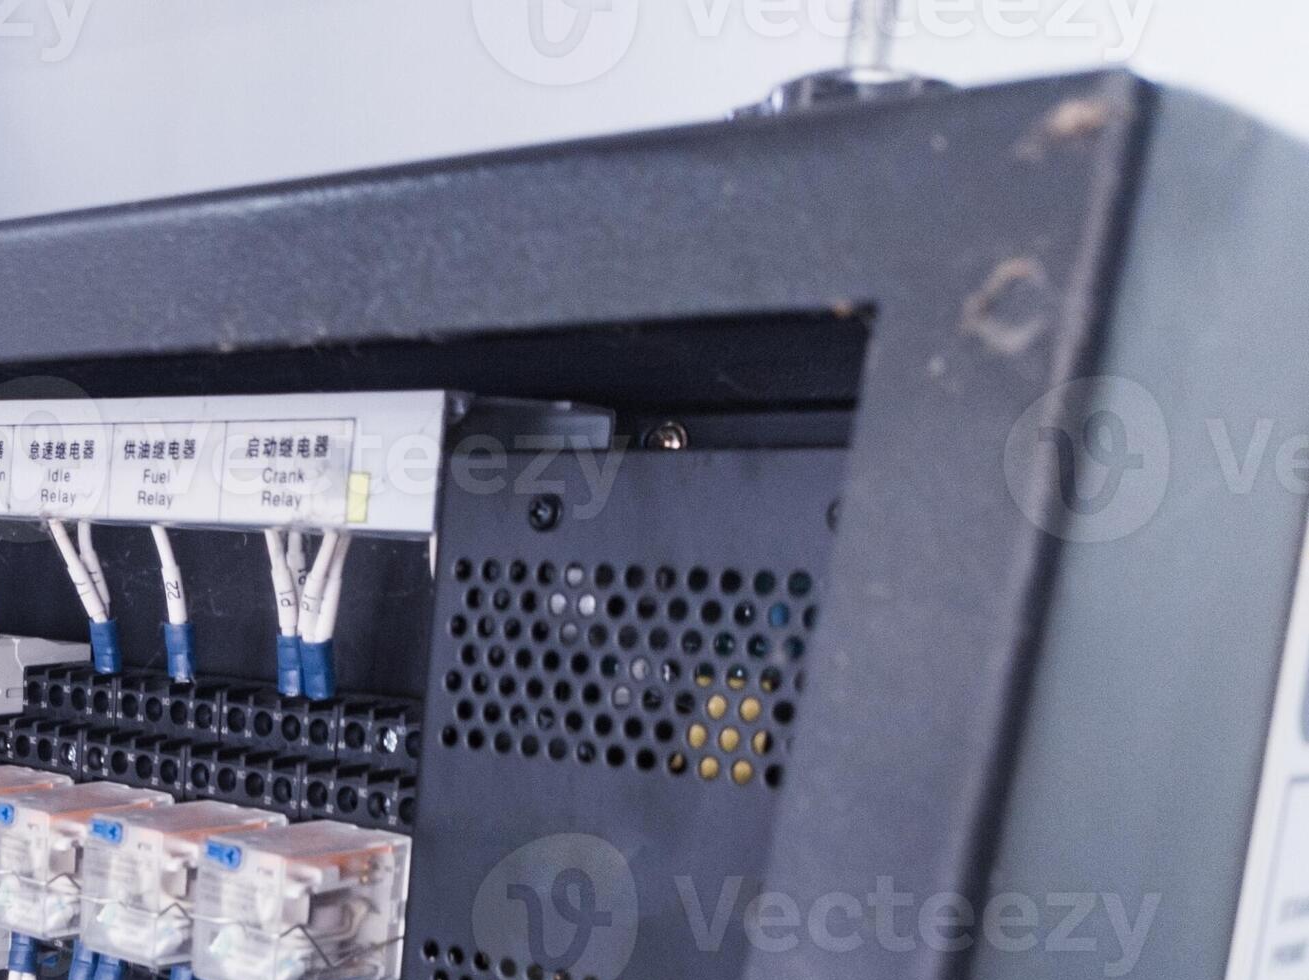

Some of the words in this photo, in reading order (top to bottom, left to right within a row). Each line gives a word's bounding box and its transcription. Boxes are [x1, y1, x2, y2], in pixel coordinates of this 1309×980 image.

[28, 440, 95, 461] 怠速继电器
[124, 439, 196, 460] 供油继电器
[245, 435, 329, 459] 启动继电器
[48, 469, 71, 483] Idle
[143, 469, 170, 484] Fuel
[262, 467, 305, 483] Crank
[40, 488, 77, 505] Relay
[137, 490, 174, 508] Relay
[261, 491, 302, 510] Relay
[166, 579, 182, 601] 22
